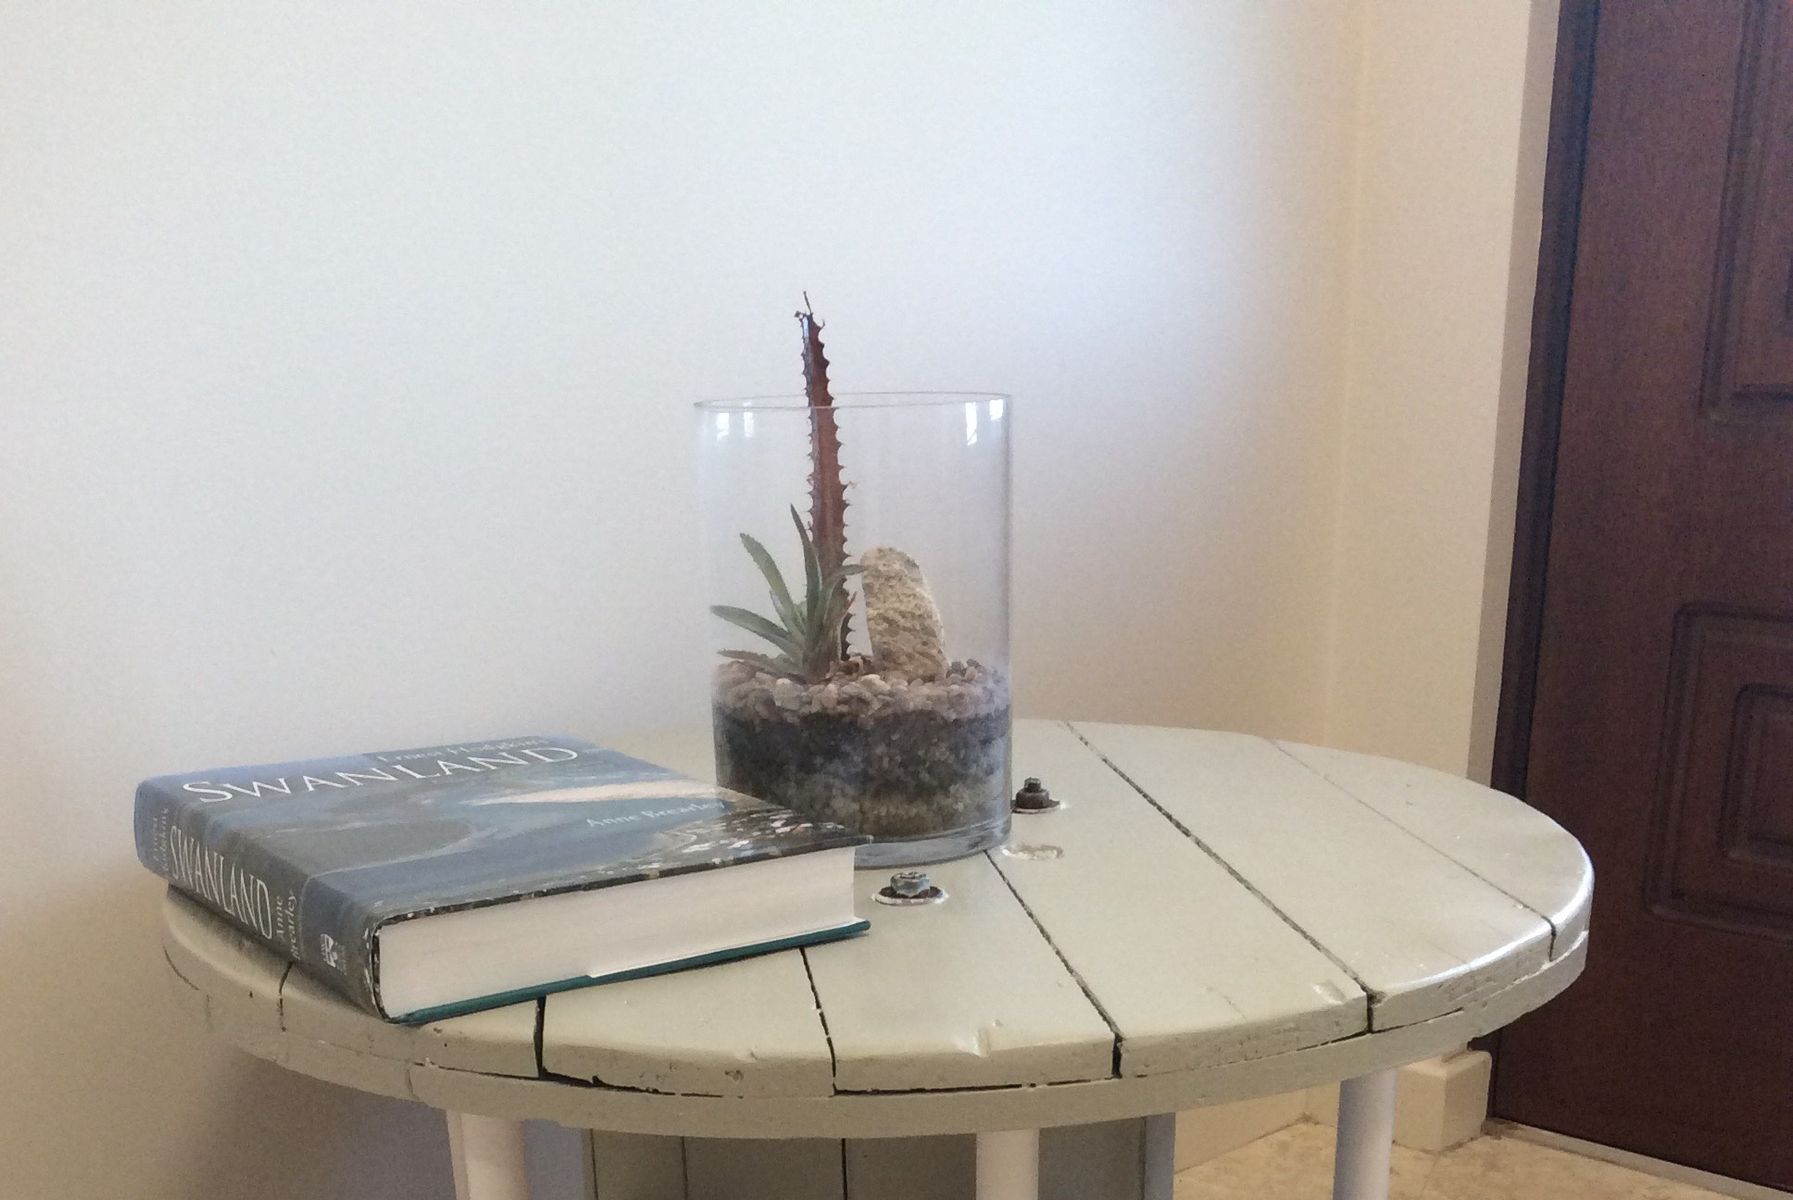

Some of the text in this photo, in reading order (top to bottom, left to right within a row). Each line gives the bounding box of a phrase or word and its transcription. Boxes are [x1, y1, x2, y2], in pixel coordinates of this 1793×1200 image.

[181, 747, 579, 804] SWANLAND
[586, 814, 640, 828] Anne
[170, 825, 272, 940] SWANLAND
